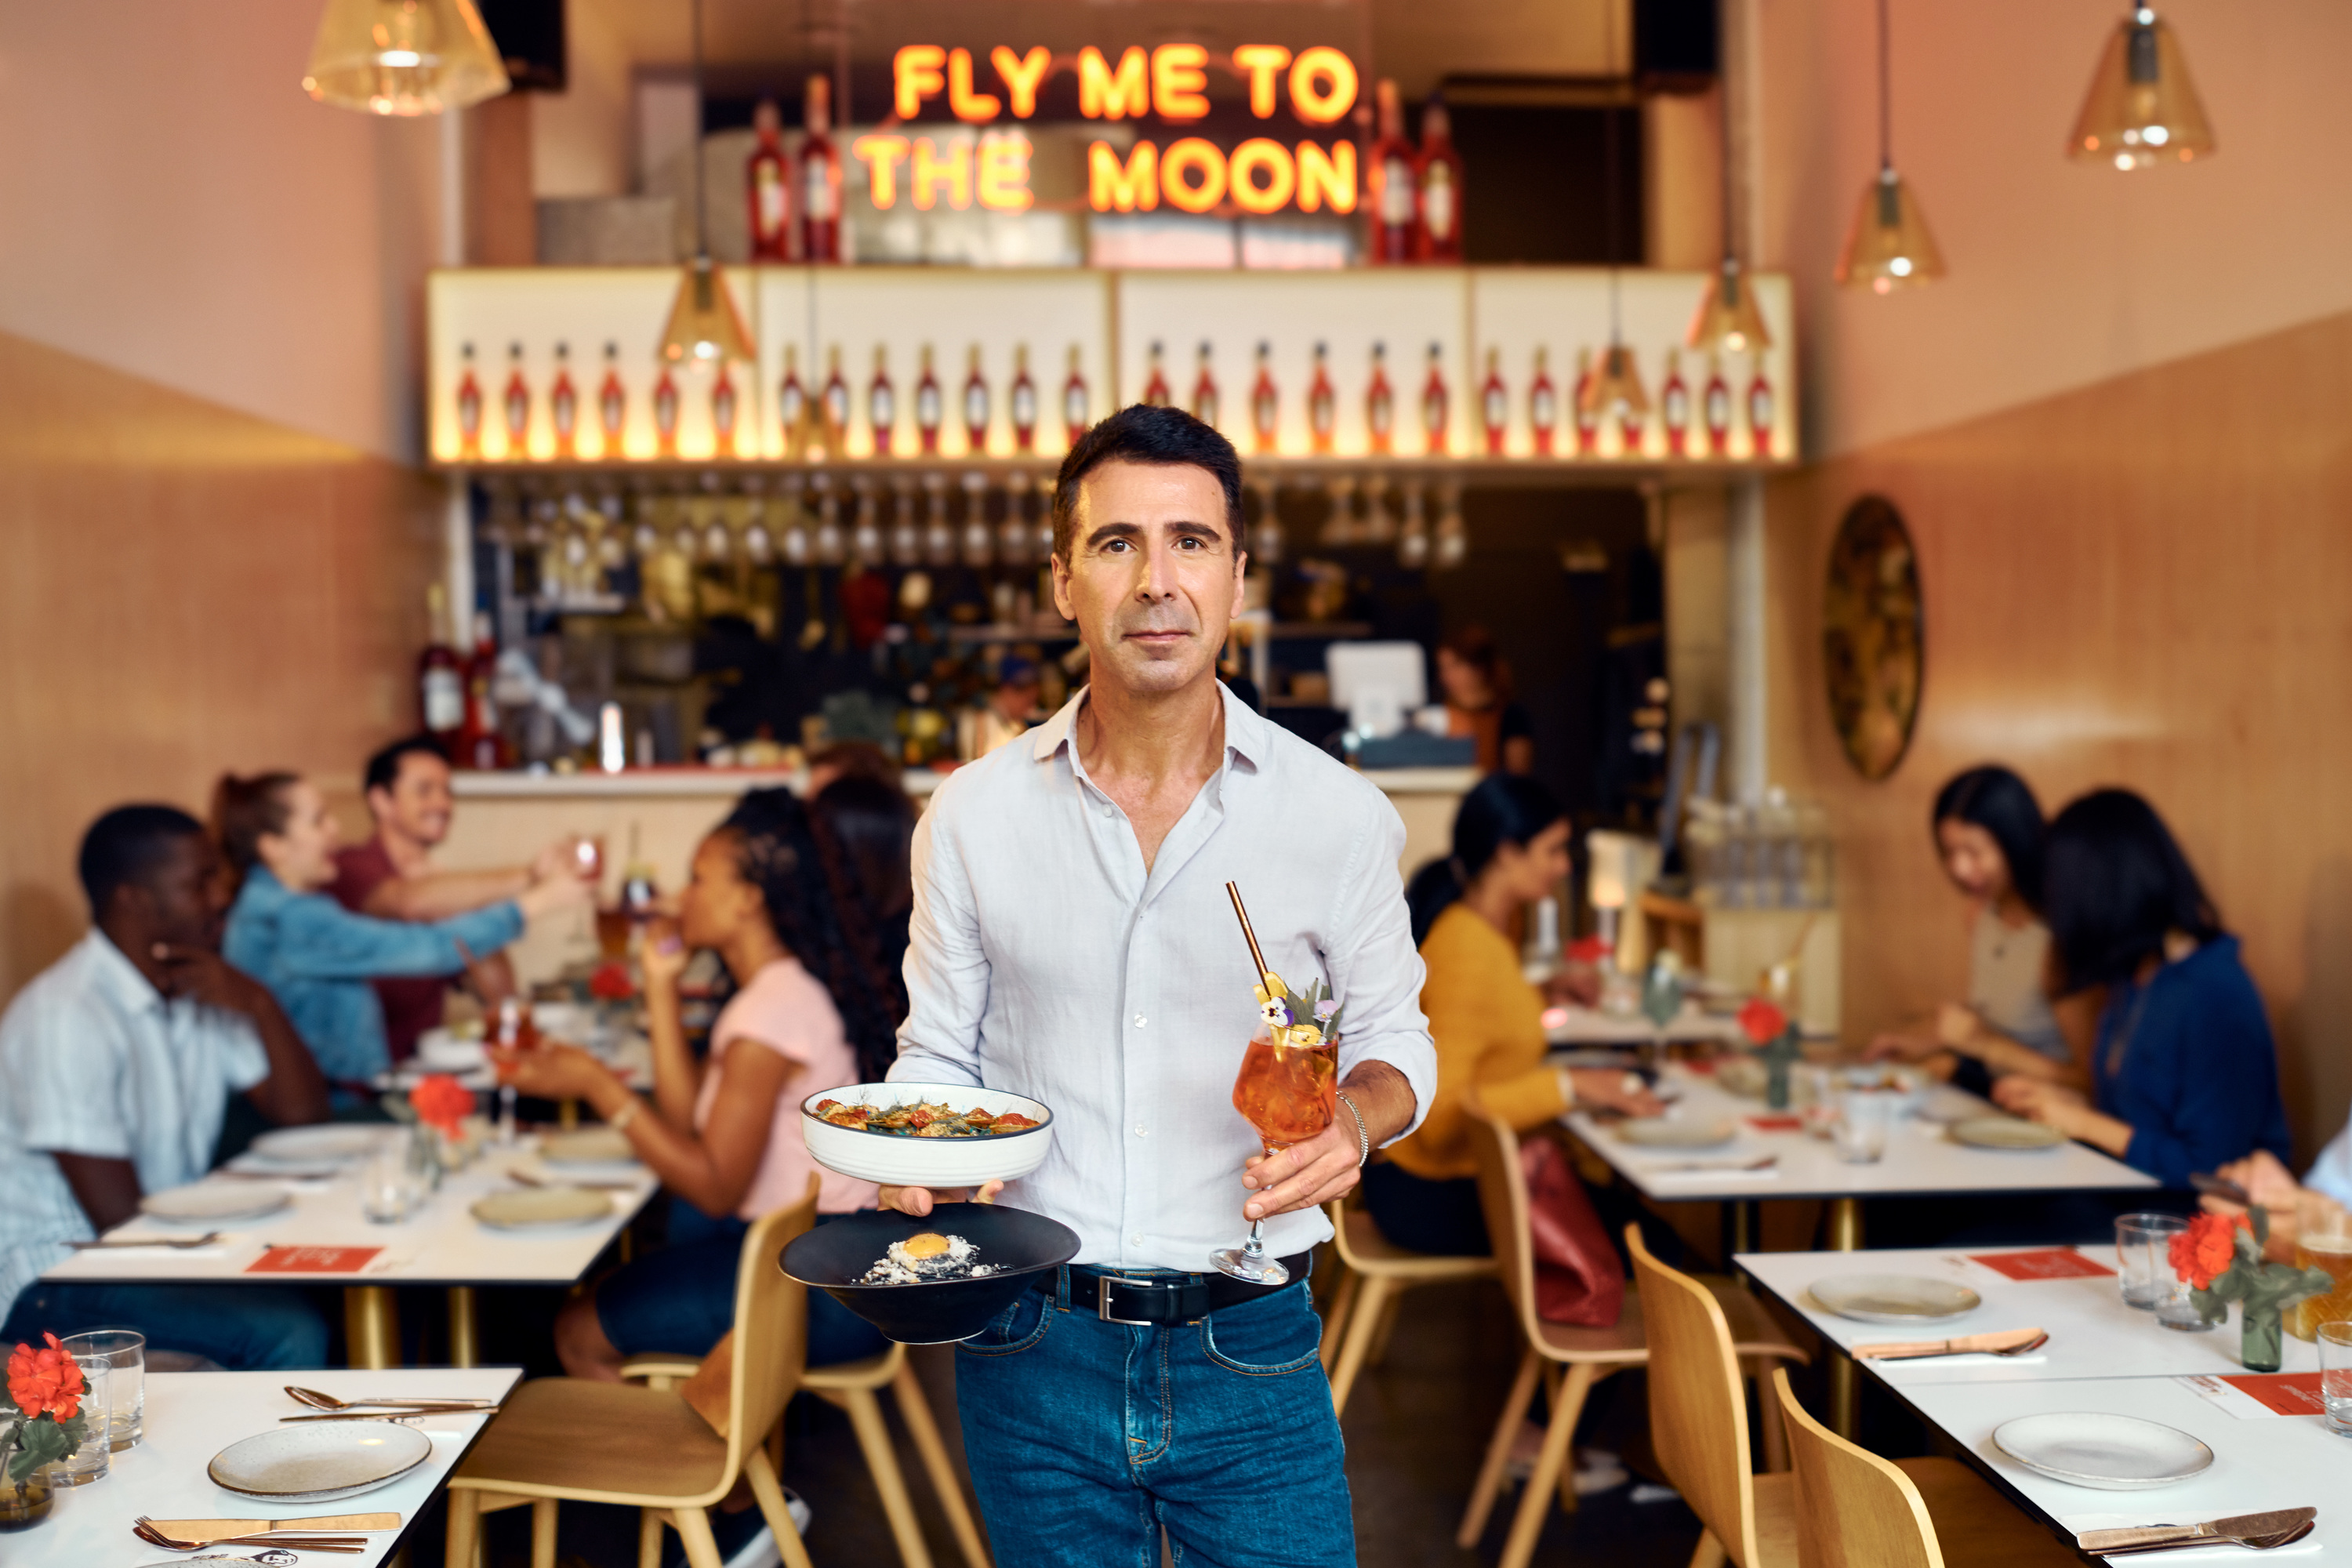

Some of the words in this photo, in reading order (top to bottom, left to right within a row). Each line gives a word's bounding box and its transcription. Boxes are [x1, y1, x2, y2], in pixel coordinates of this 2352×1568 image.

[892, 43, 1052, 121] FLY
[1077, 43, 1210, 121] ME
[1232, 44, 1360, 124] TO
[851, 133, 1035, 213] THE
[1087, 136, 1359, 215] MOON
